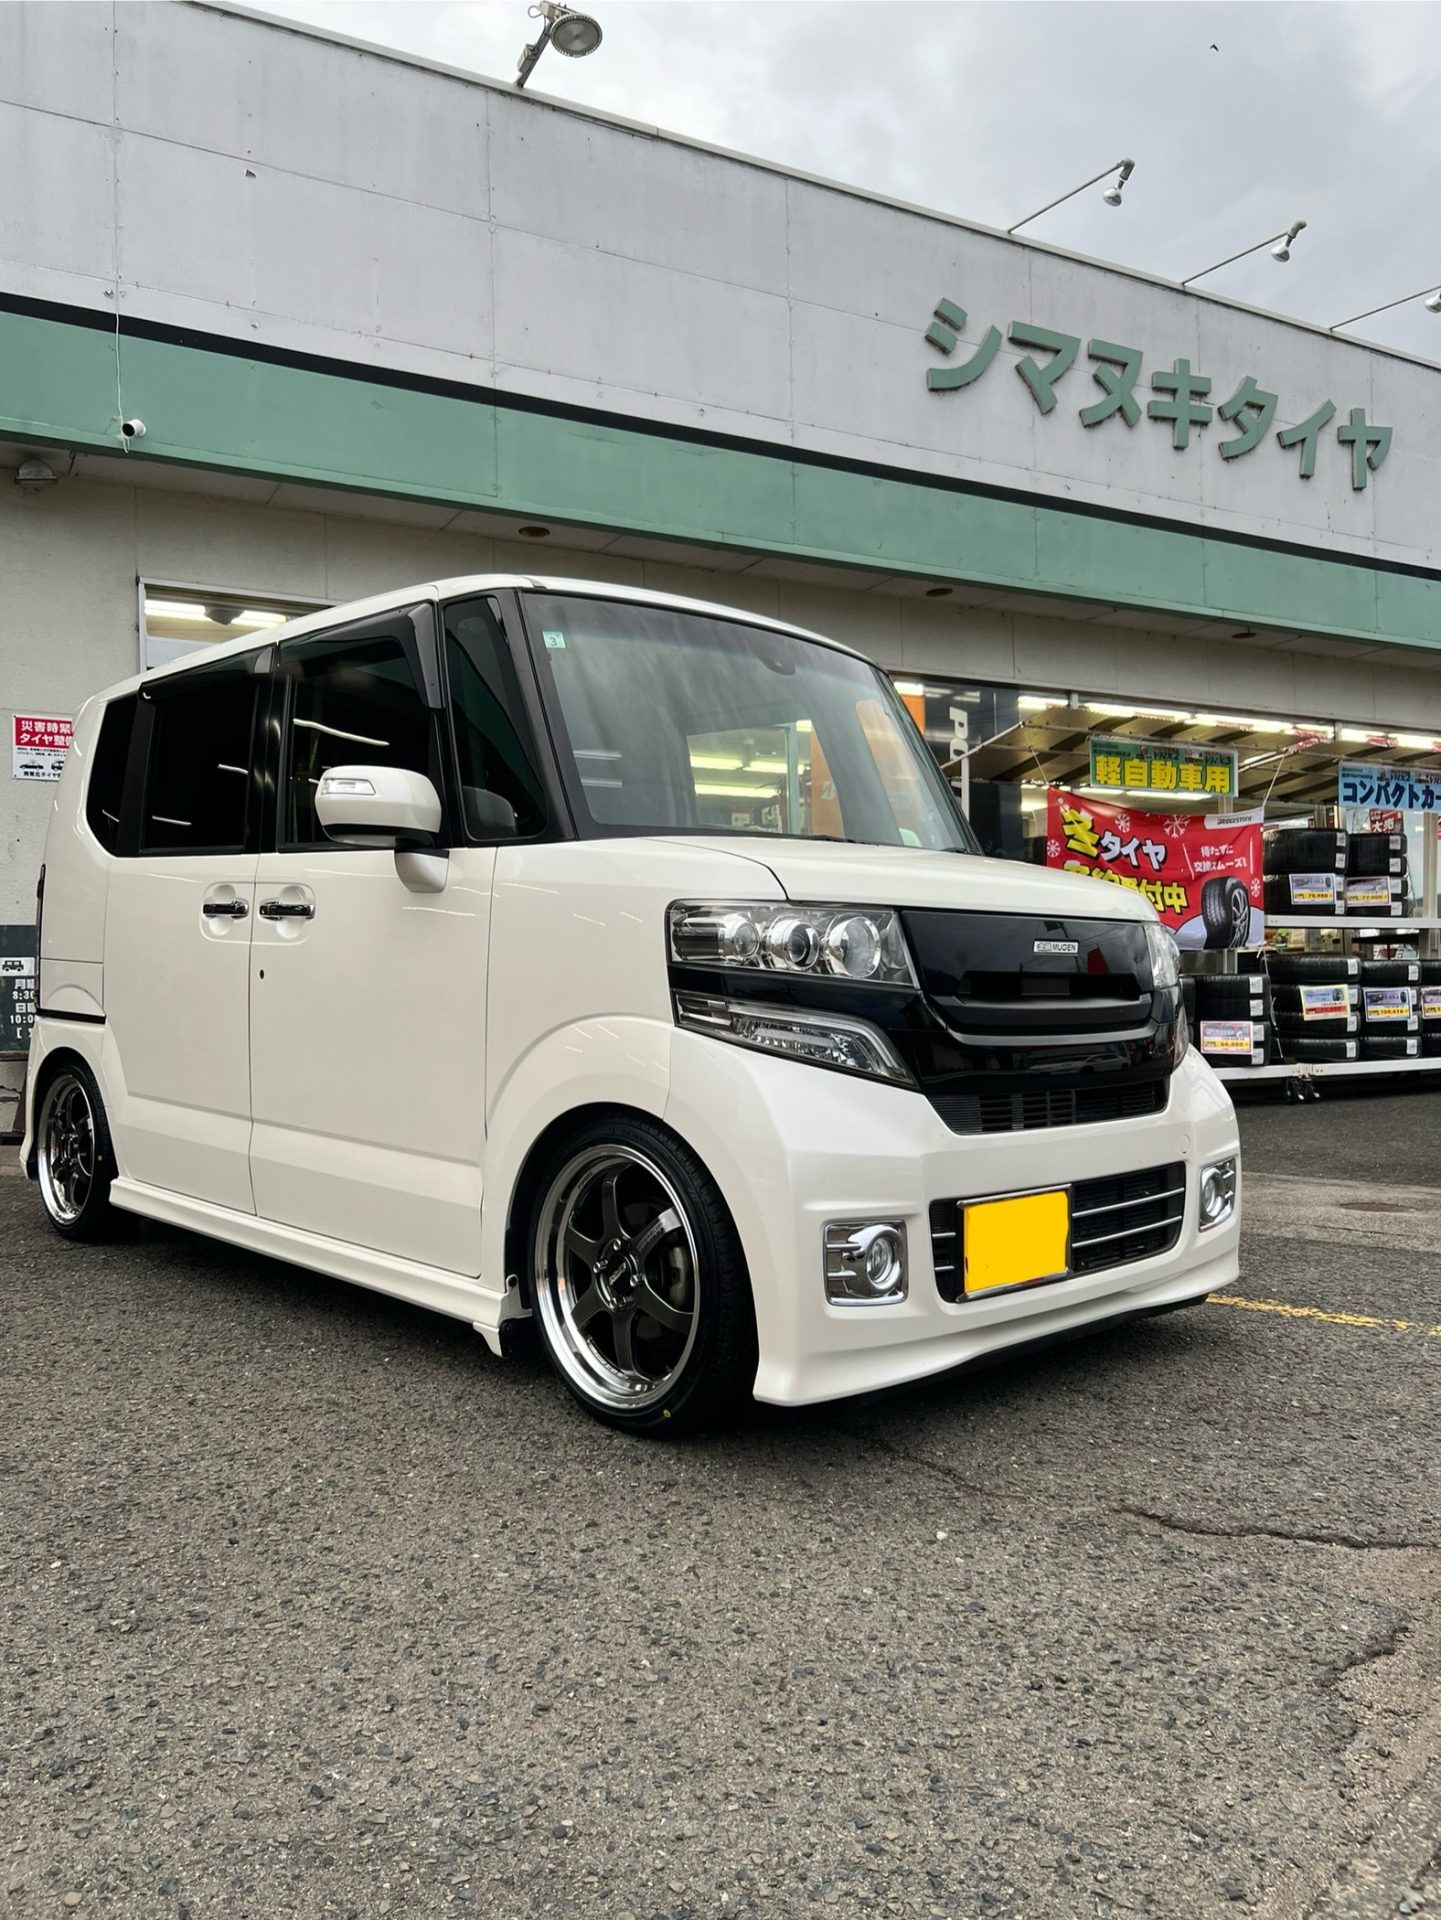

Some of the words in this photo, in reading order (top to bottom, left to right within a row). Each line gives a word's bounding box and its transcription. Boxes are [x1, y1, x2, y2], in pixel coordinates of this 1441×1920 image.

[925, 297, 1393, 490] シマヌキタイヤ
[21, 720, 73, 734] 災害時緊
[1096, 755, 1230, 793] 軽自動車用
[1062, 808, 1166, 871] 冬タイヤ
[1052, 943, 1077, 952] MUGEN
